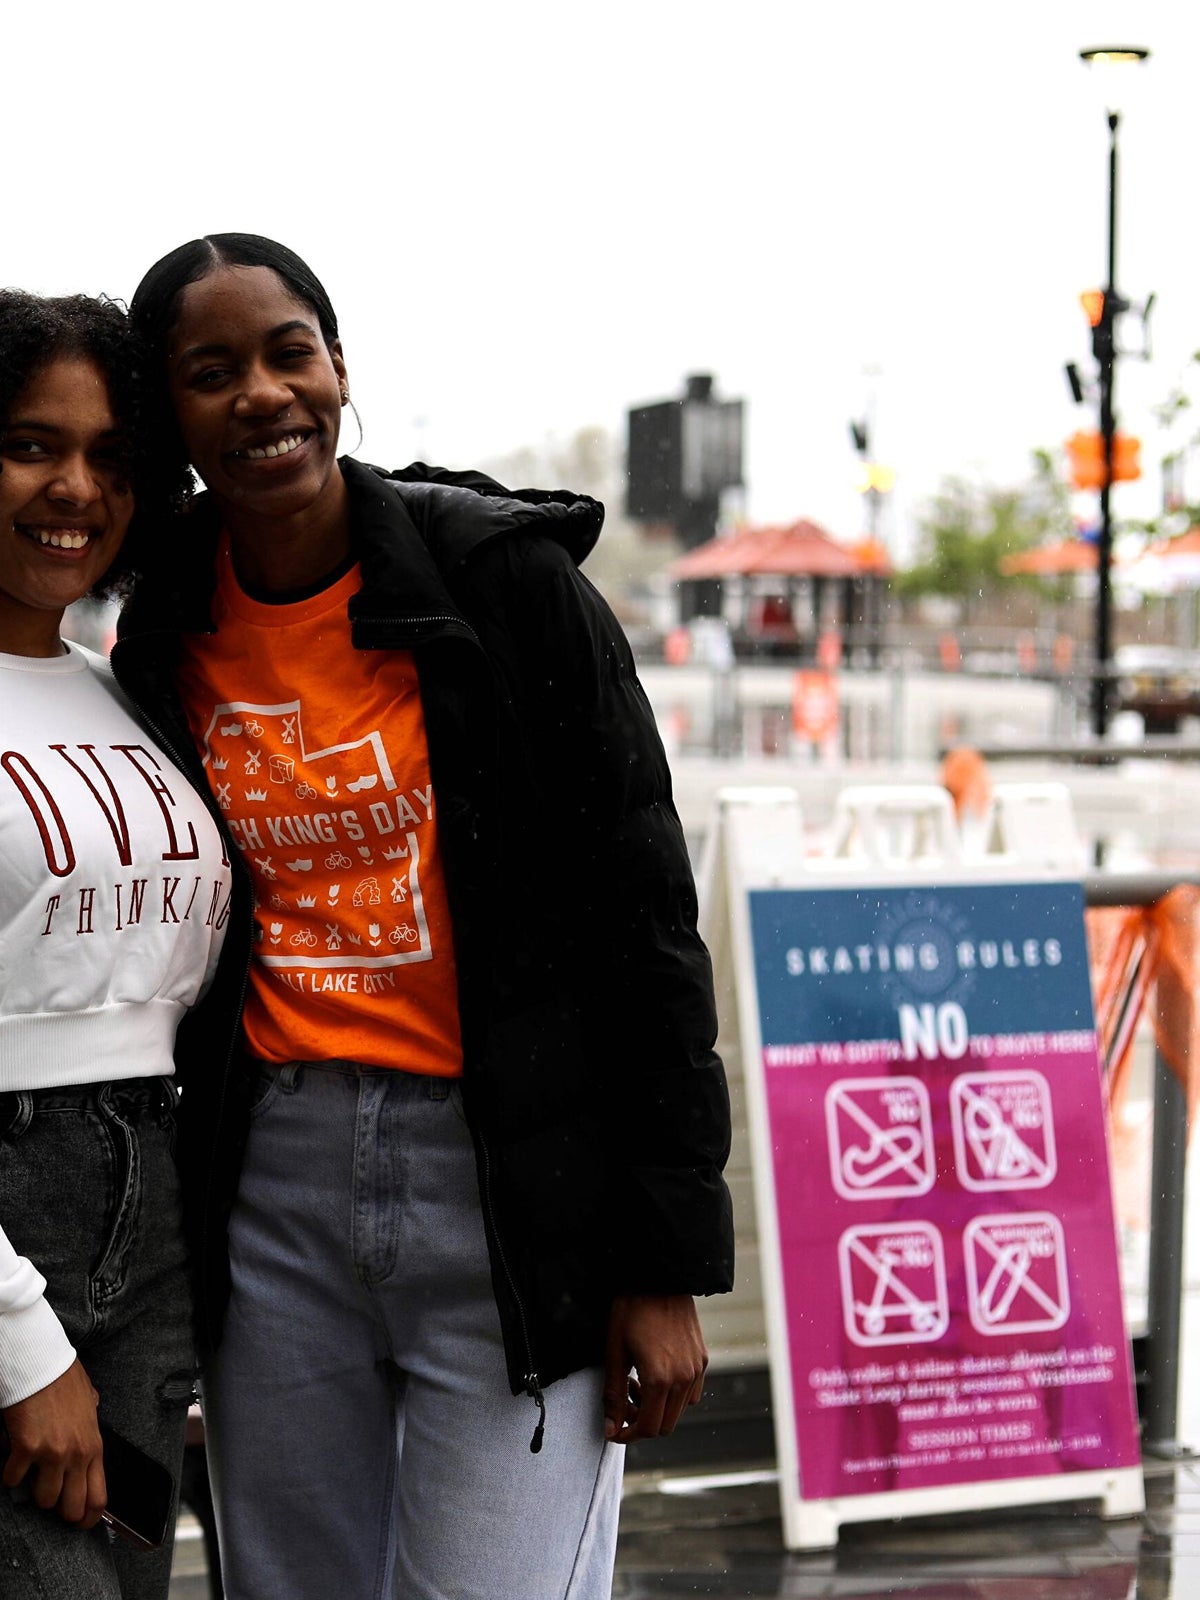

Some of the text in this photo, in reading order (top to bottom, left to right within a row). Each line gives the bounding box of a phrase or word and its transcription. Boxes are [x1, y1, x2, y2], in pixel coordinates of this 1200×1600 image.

[1, 744, 231, 877] OVE
[266, 810, 365, 847] KING'S
[369, 784, 433, 836] DAY
[41, 876, 231, 936] THINKING
[311, 973, 359, 993] LAKE
[363, 971, 396, 994] CITY
[786, 938, 1062, 976] SKATING RULES
[767, 1044, 816, 1067] WHAT
[898, 1001, 969, 1062] NO
[995, 1033, 1046, 1056] SKATE
